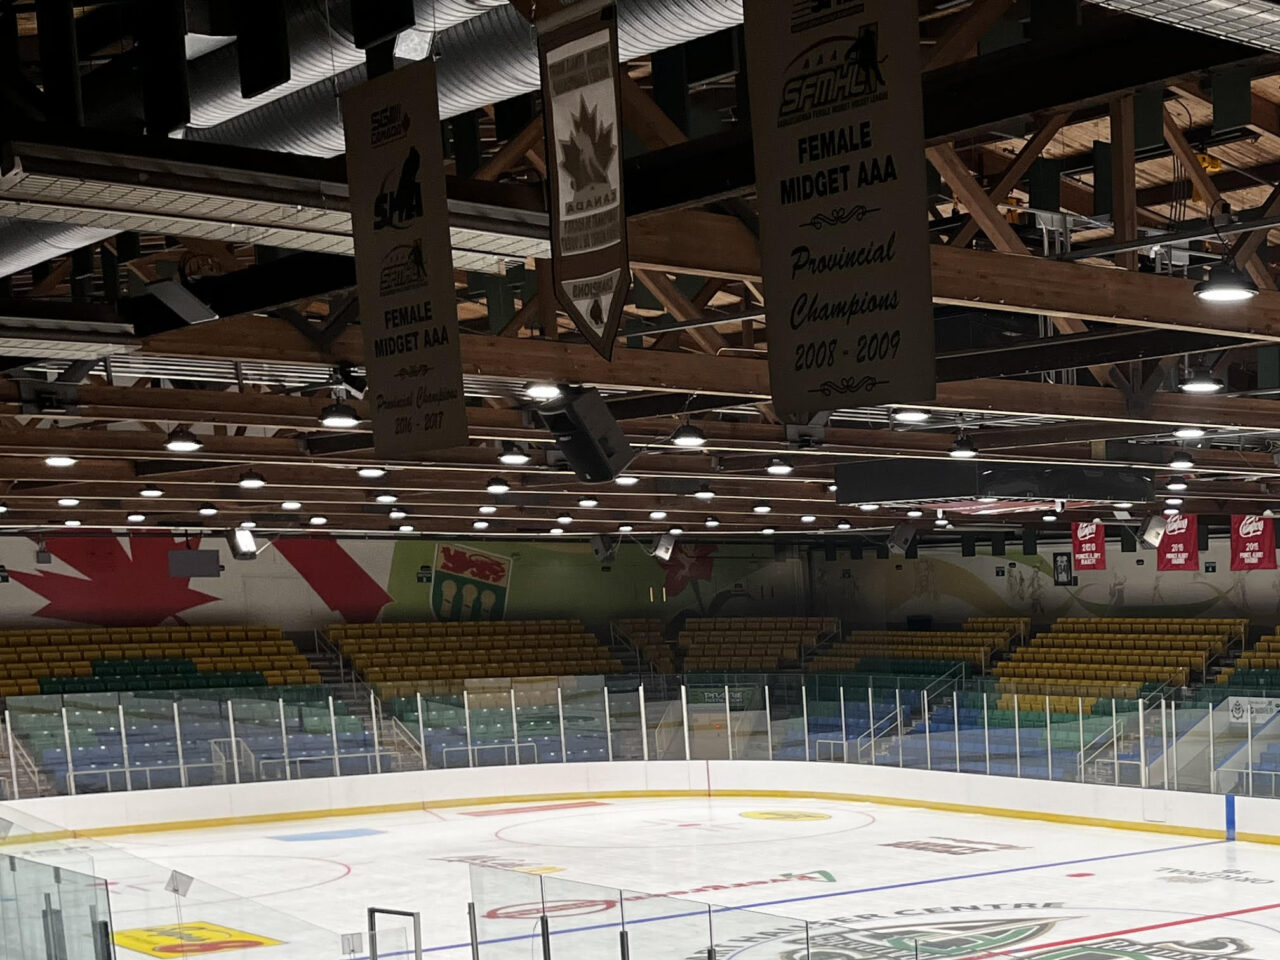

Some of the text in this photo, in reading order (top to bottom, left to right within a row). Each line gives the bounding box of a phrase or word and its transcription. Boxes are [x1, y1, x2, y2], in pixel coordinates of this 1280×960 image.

[799, 121, 872, 164] FEMALE
[780, 155, 898, 205] MIDGET AAA
[791, 231, 896, 280] Provincial
[384, 301, 433, 330] FEMALE
[790, 290, 899, 330] Champions
[374, 325, 449, 358] MIDGET AAA
[795, 338, 838, 371] 2008
[856, 330, 900, 363] 2009
[894, 902, 1066, 915] CENTRE
